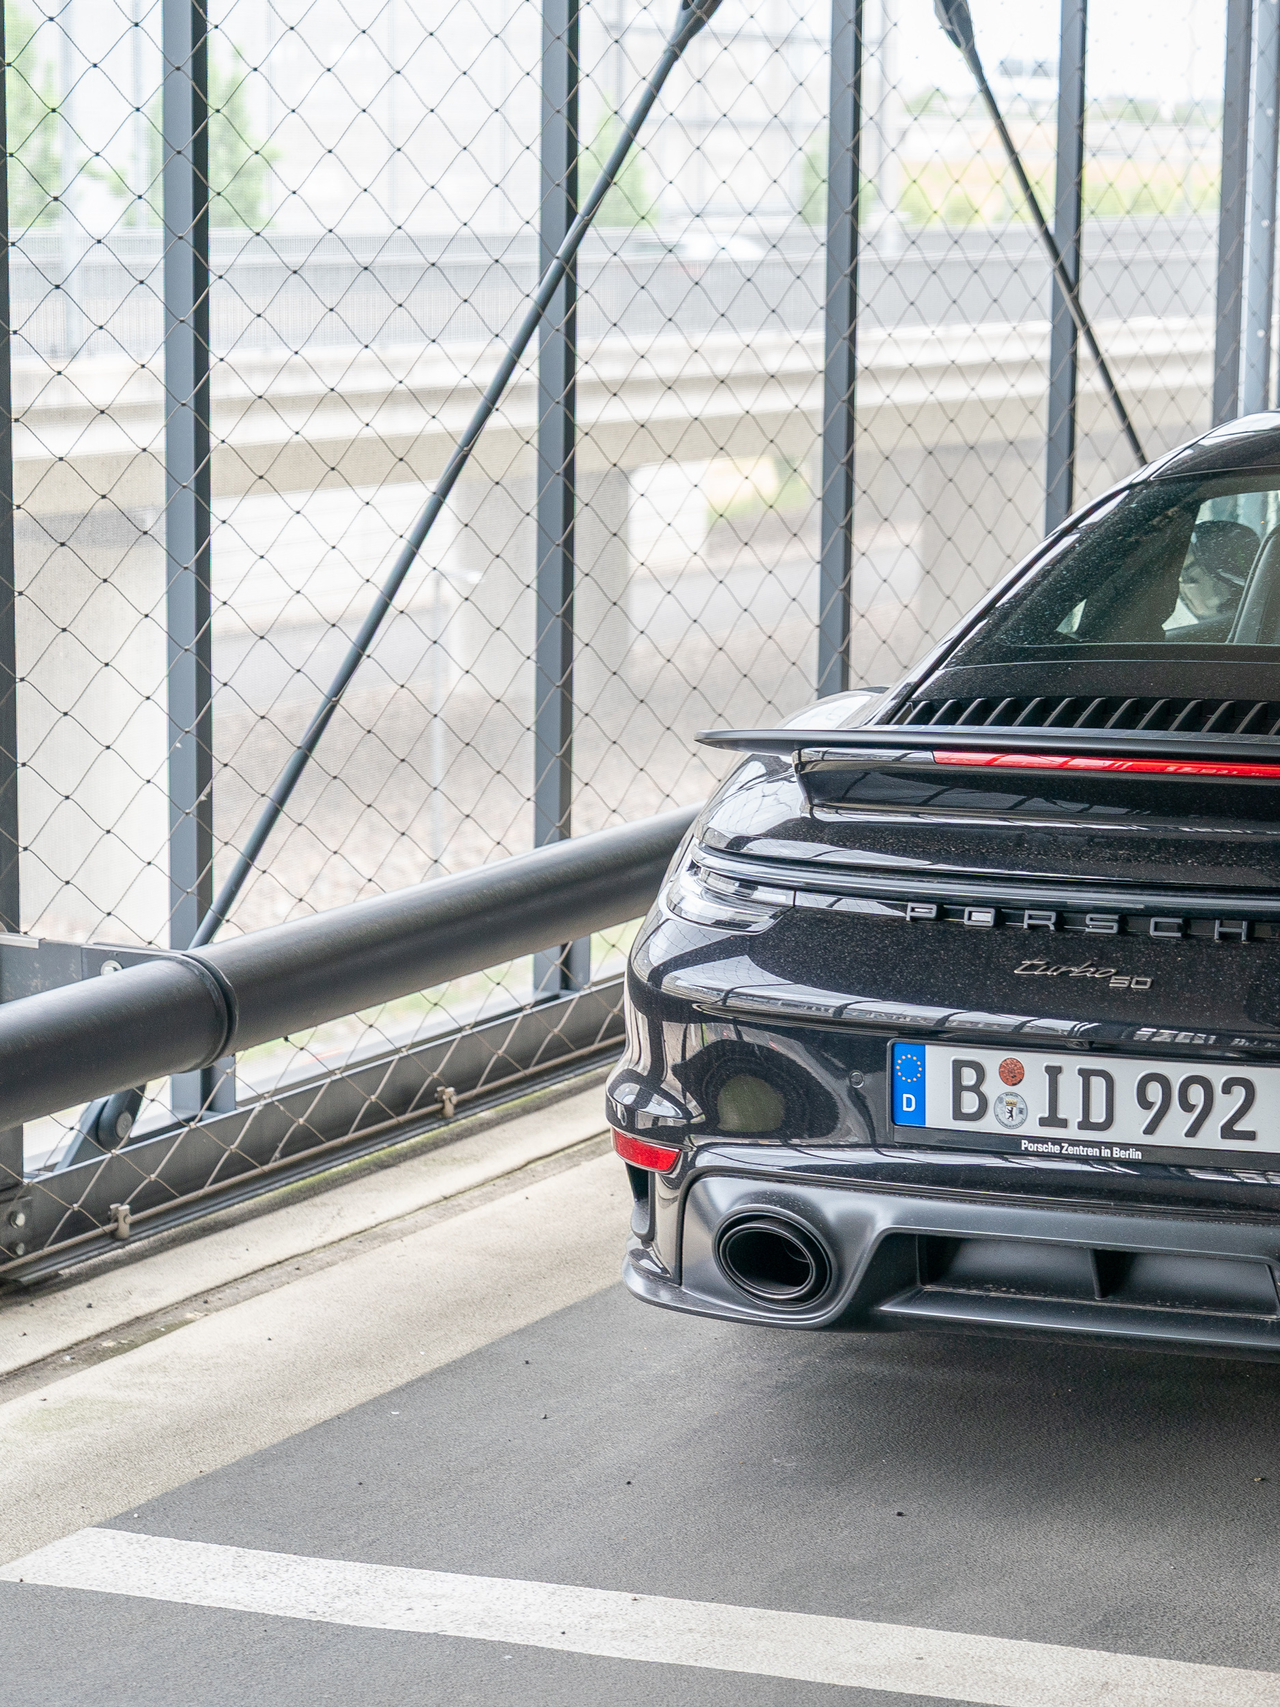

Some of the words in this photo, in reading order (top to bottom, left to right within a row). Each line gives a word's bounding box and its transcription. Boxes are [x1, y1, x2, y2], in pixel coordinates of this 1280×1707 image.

[1013, 957, 1118, 978] turbo
[1109, 975, 1153, 989] 50
[902, 1093, 916, 1112] D
[951, 1059, 988, 1121] B
[1038, 1065, 1114, 1131] ID
[1136, 1072, 1257, 1142] 992
[1021, 1140, 1060, 1154] Porsche
[1061, 1143, 1100, 1157] Zentren
[1101, 1146, 1111, 1158] in
[1112, 1146, 1142, 1160] Berlin
